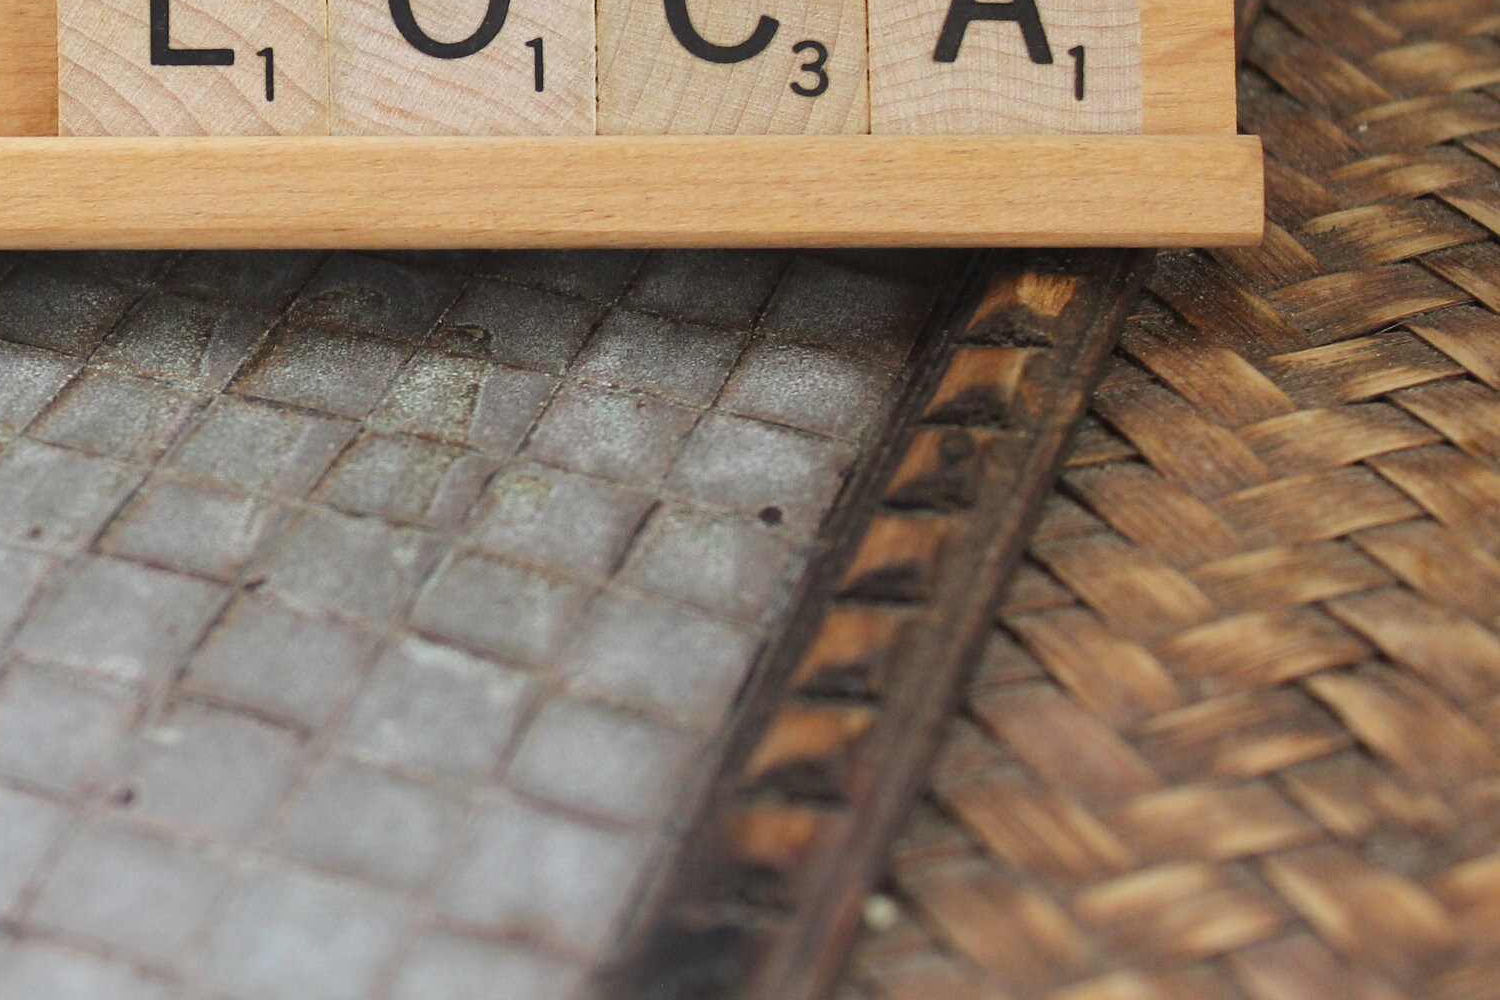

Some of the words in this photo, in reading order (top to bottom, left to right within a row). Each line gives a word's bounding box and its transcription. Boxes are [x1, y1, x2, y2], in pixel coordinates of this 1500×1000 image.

[254, 45, 276, 103] 1
[524, 36, 545, 94] 1
[788, 38, 830, 99] 3
[1066, 43, 1086, 102] 1
